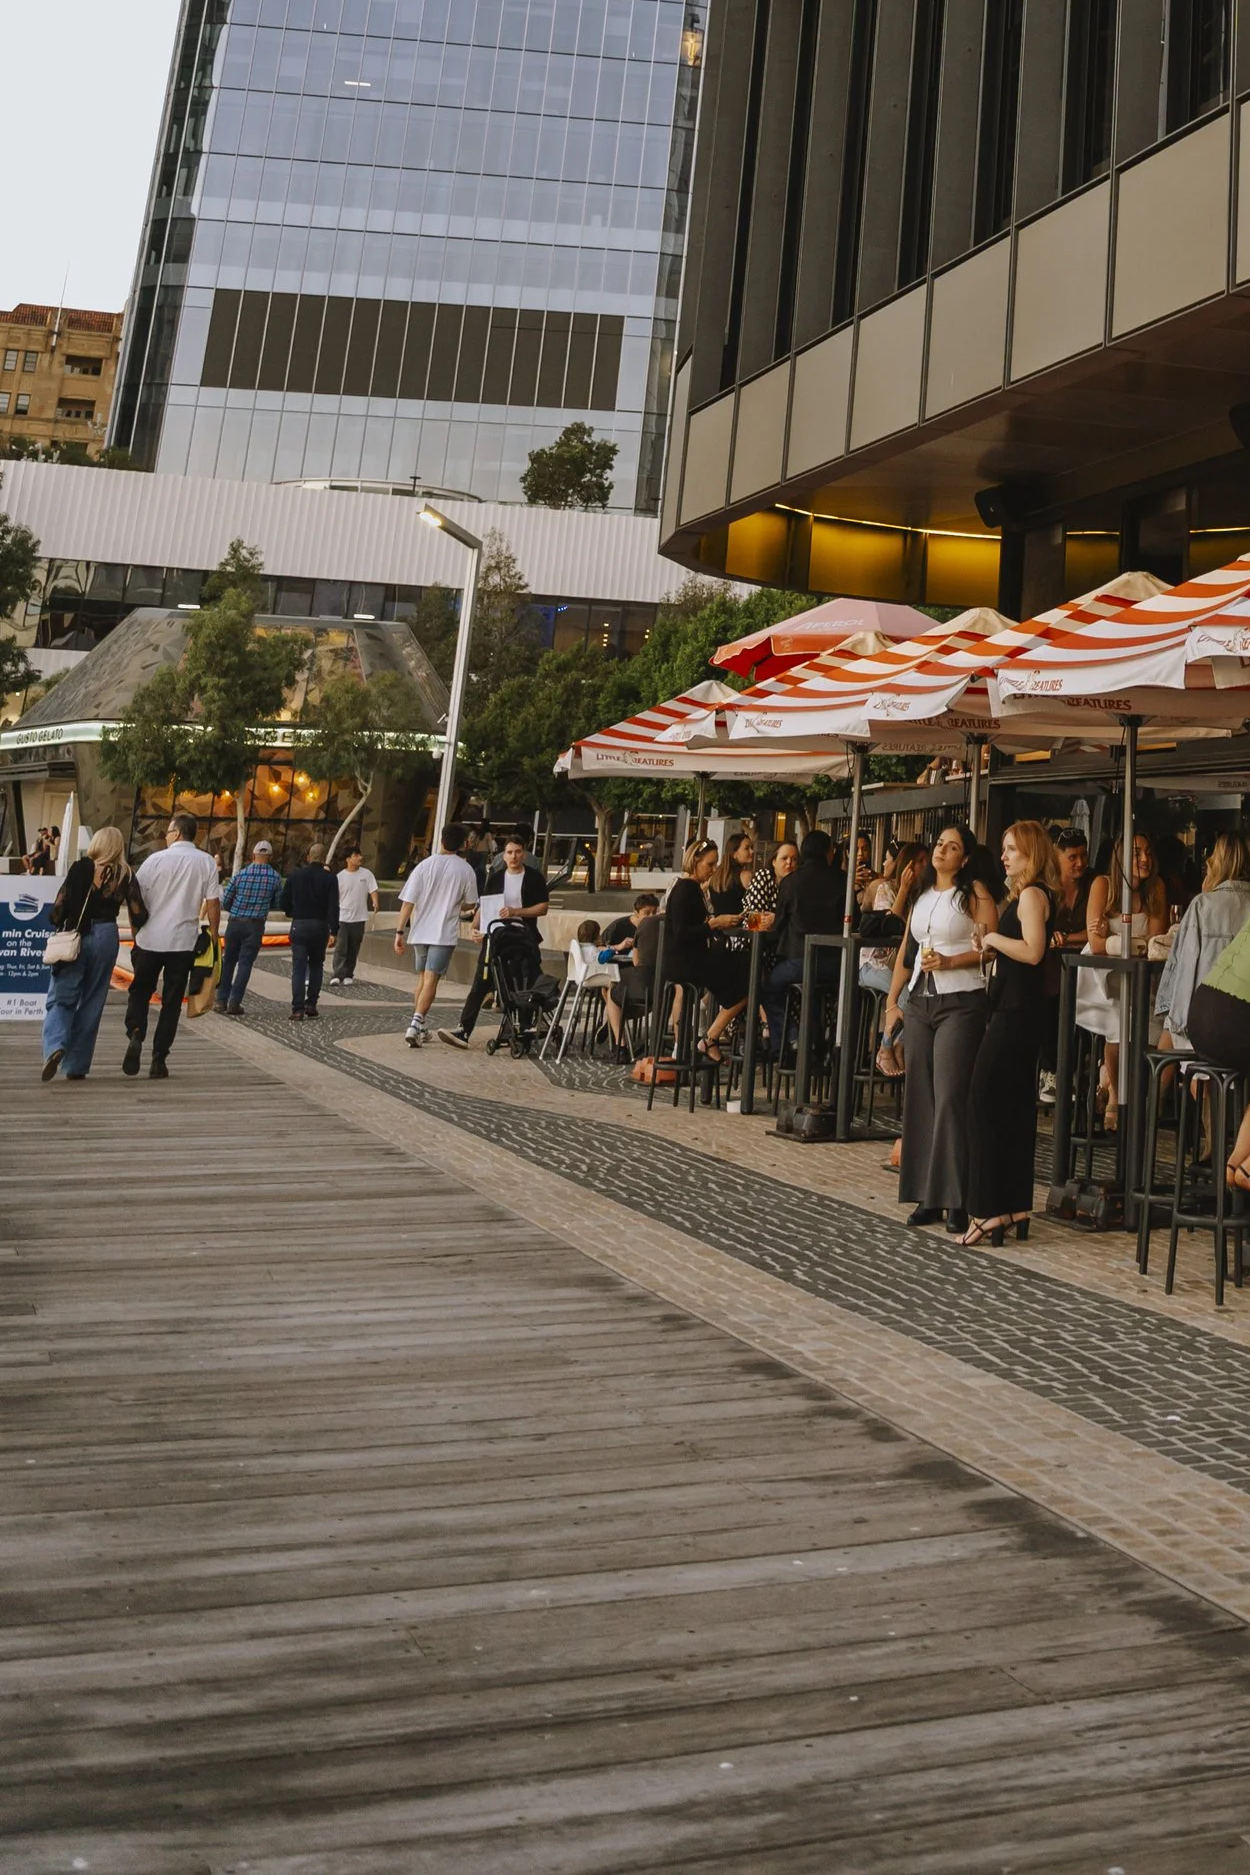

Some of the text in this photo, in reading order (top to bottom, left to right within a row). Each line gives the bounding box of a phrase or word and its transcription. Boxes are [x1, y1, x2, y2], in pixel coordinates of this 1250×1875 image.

[793, 618, 866, 631] APEROL
[16, 728, 64, 745] GUSTO GELATO
[2, 929, 22, 938] min
[19, 938, 32, 947] the
[15, 1007, 22, 1015] in
[24, 1007, 44, 1015] Perth
